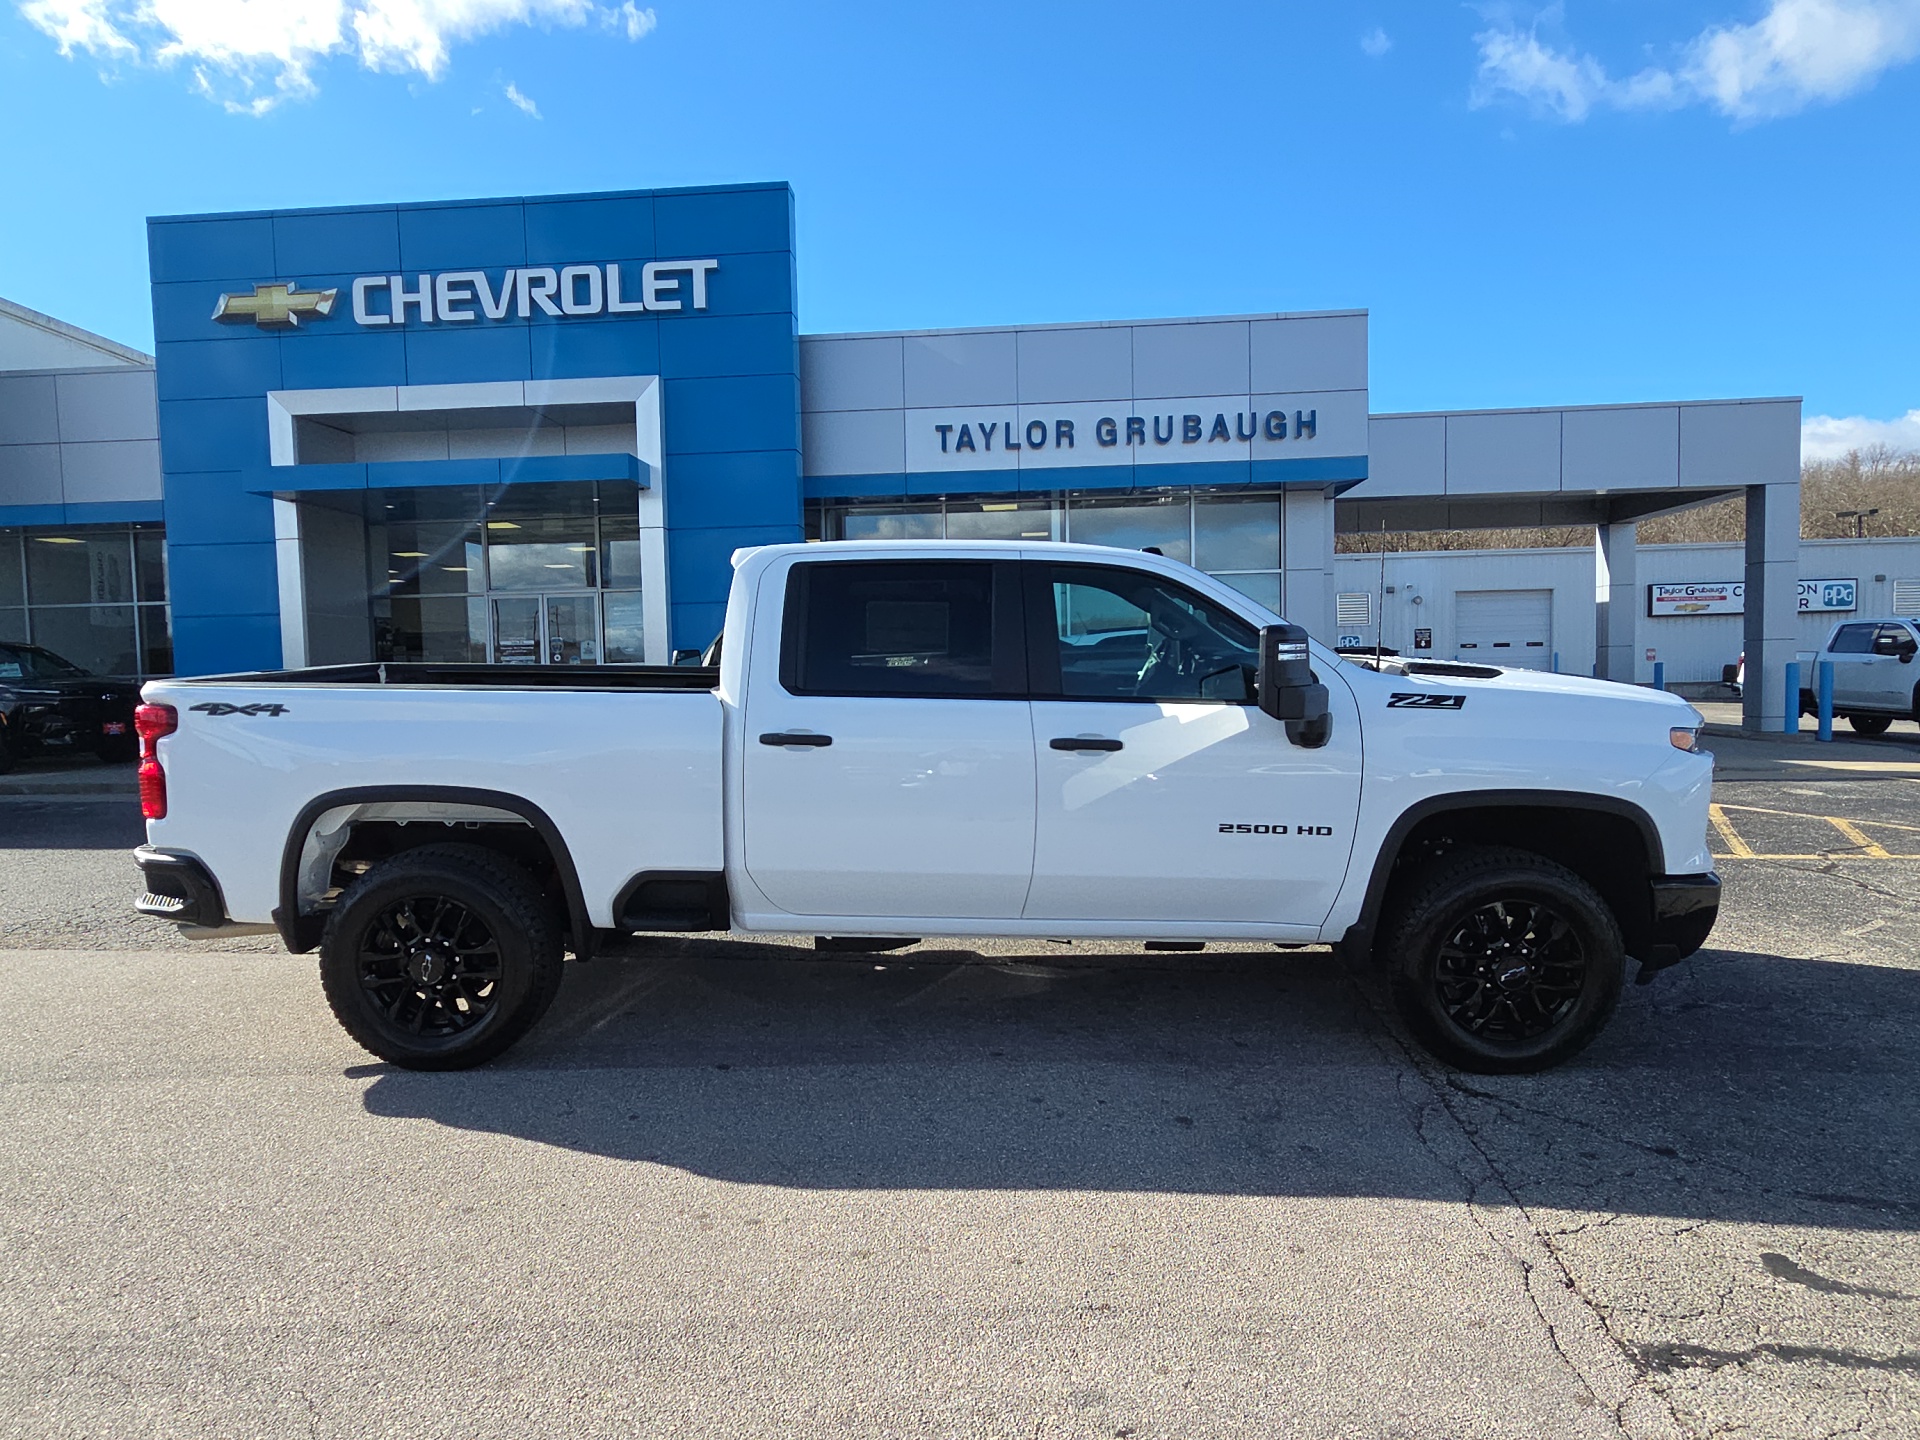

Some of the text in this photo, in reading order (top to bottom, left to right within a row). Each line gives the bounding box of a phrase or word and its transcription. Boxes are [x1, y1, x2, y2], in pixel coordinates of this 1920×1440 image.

[352, 258, 718, 325] CHEVROLET
[935, 409, 1317, 453] TAYLOR GRUBAUGH
[1656, 586, 1684, 597] Taylor
[1685, 585, 1728, 596] Grubaugh
[1824, 586, 1853, 605] PPG
[1341, 637, 1359, 648] PPG
[1386, 692, 1467, 710] Z71
[1218, 823, 1333, 836] 2500 HD
